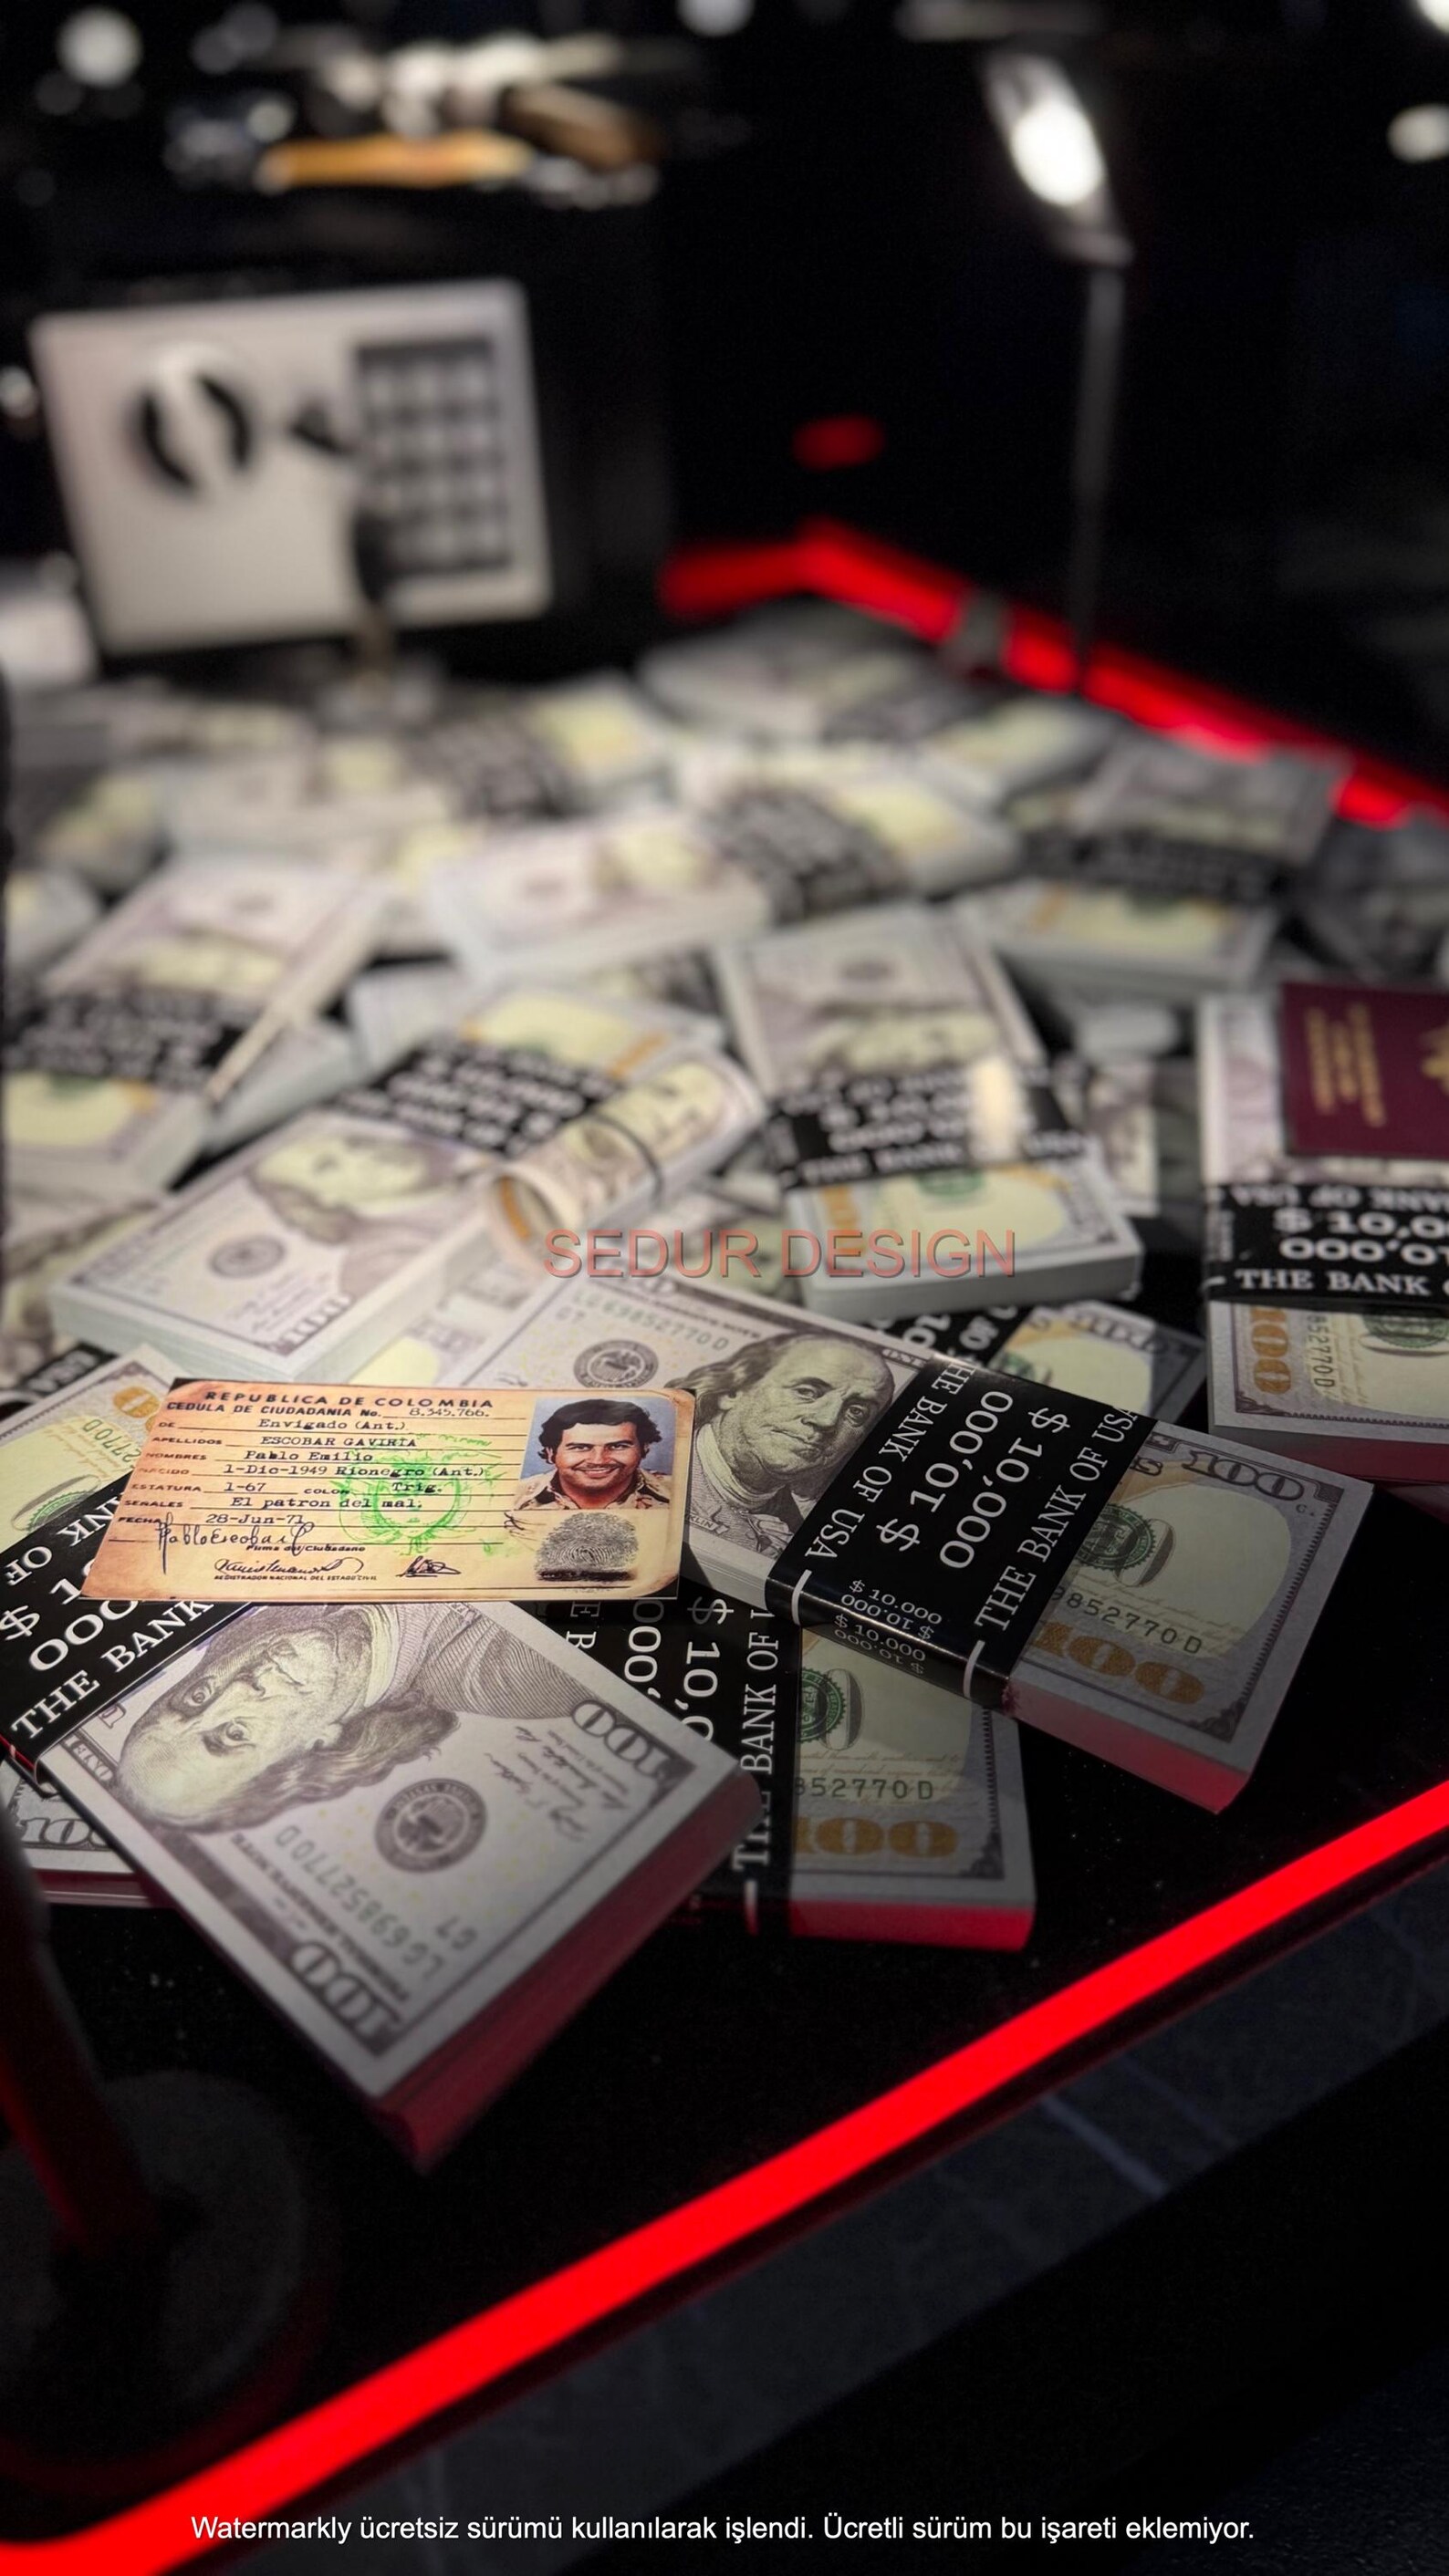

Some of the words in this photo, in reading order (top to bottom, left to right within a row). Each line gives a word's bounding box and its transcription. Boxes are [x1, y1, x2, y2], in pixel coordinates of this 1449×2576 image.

[1326, 1209, 1449, 1240] 10,0
[1234, 1268, 1315, 1291] THE
[1324, 1270, 1433, 1297] BANK
[166, 1401, 225, 1413] CEDULA
[233, 1405, 254, 1414] DE
[260, 1406, 352, 1417] CIUDADANIA
[360, 1408, 382, 1418] No.
[204, 1391, 328, 1406] REPUBLICA
[339, 1397, 365, 1406] DE
[374, 1397, 494, 1408] COLOMBIA
[257, 1418, 348, 1430] Envigado
[355, 1420, 406, 1431] (Ant.)
[878, 1395, 948, 1463] BANK
[145, 1451, 207, 1460] NOMBRES
[308, 1451, 373, 1461] Emilio
[151, 1436, 223, 1445] APELLIDOS
[260, 1436, 336, 1447] ESCOBAR
[910, 1390, 1014, 1513] 10,000
[130, 1483, 202, 1492] ESTATURA
[224, 1482, 267, 1492] 1-67
[138, 1467, 190, 1475] NACIDO
[335, 1465, 425, 1478] Rionegro
[433, 1467, 485, 1477] (Ant.)
[851, 1465, 892, 1503] OF
[1182, 1449, 1305, 1501] 100
[232, 1497, 252, 1506] El
[263, 1499, 331, 1510] patron
[339, 1498, 371, 1508] del
[939, 1437, 1043, 1569] 10,000
[205, 1514, 305, 1524] 28-Jun-71
[804, 1508, 866, 1559] USA
[974, 1564, 1037, 1632] THE
[1016, 1484, 1087, 1563] BANK
[1069, 1446, 1108, 1482] OF
[4, 1546, 53, 1586] OF
[849, 1580, 866, 1593] $
[746, 1632, 779, 1671] OF
[10, 1668, 100, 1740] THE
[99, 1600, 214, 1673] BANK
[740, 1683, 777, 1775] BANK
